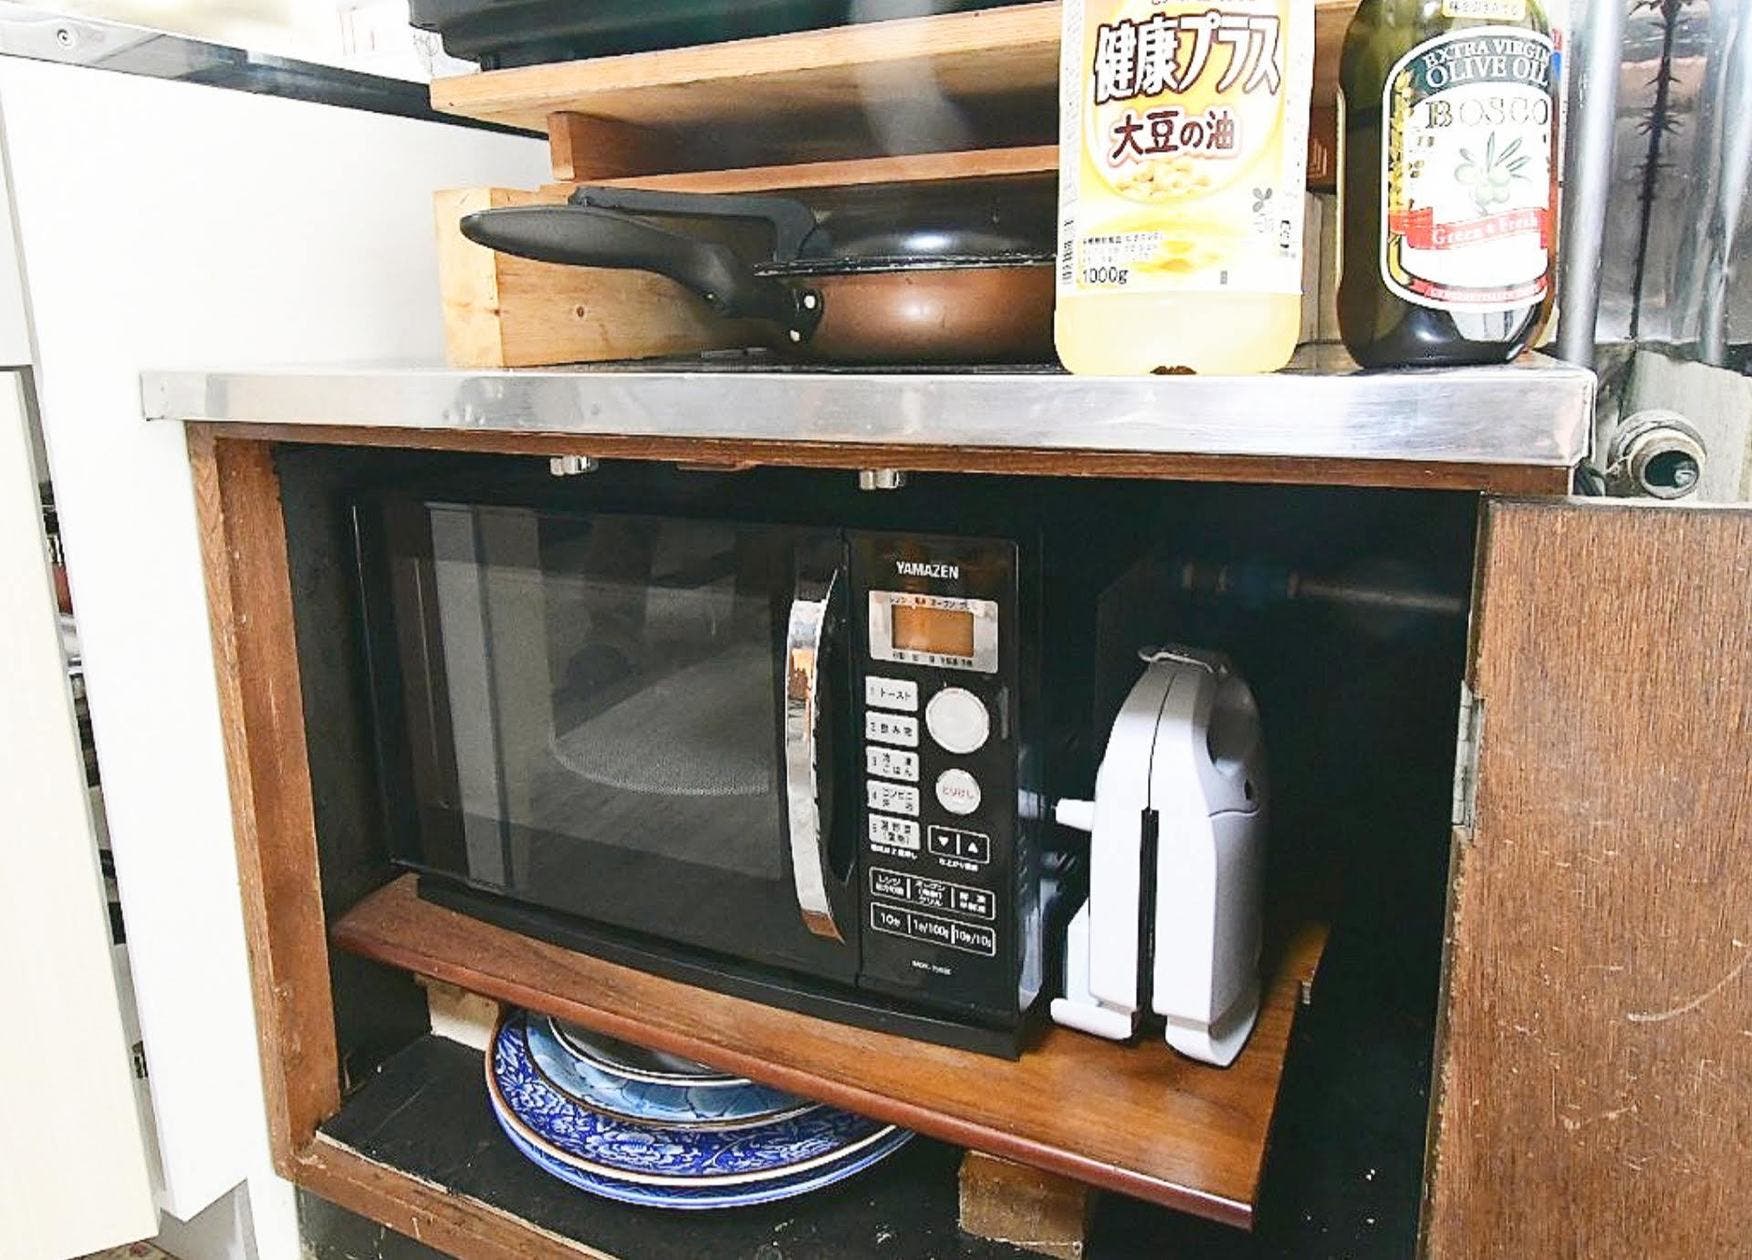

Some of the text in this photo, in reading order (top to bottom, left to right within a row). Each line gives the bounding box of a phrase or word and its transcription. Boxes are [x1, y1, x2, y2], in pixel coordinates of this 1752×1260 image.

[1094, 9, 1281, 106] 健康プラス
[1424, 40, 1490, 69] EXTRA
[1425, 56, 1550, 88] OLIVE OIL
[1425, 97, 1549, 128] BOSCO
[1112, 110, 1236, 159] 大豆の油
[1083, 266, 1129, 285] 1000g
[896, 561, 960, 580] YAMAZEN
[880, 687, 912, 701] トースト
